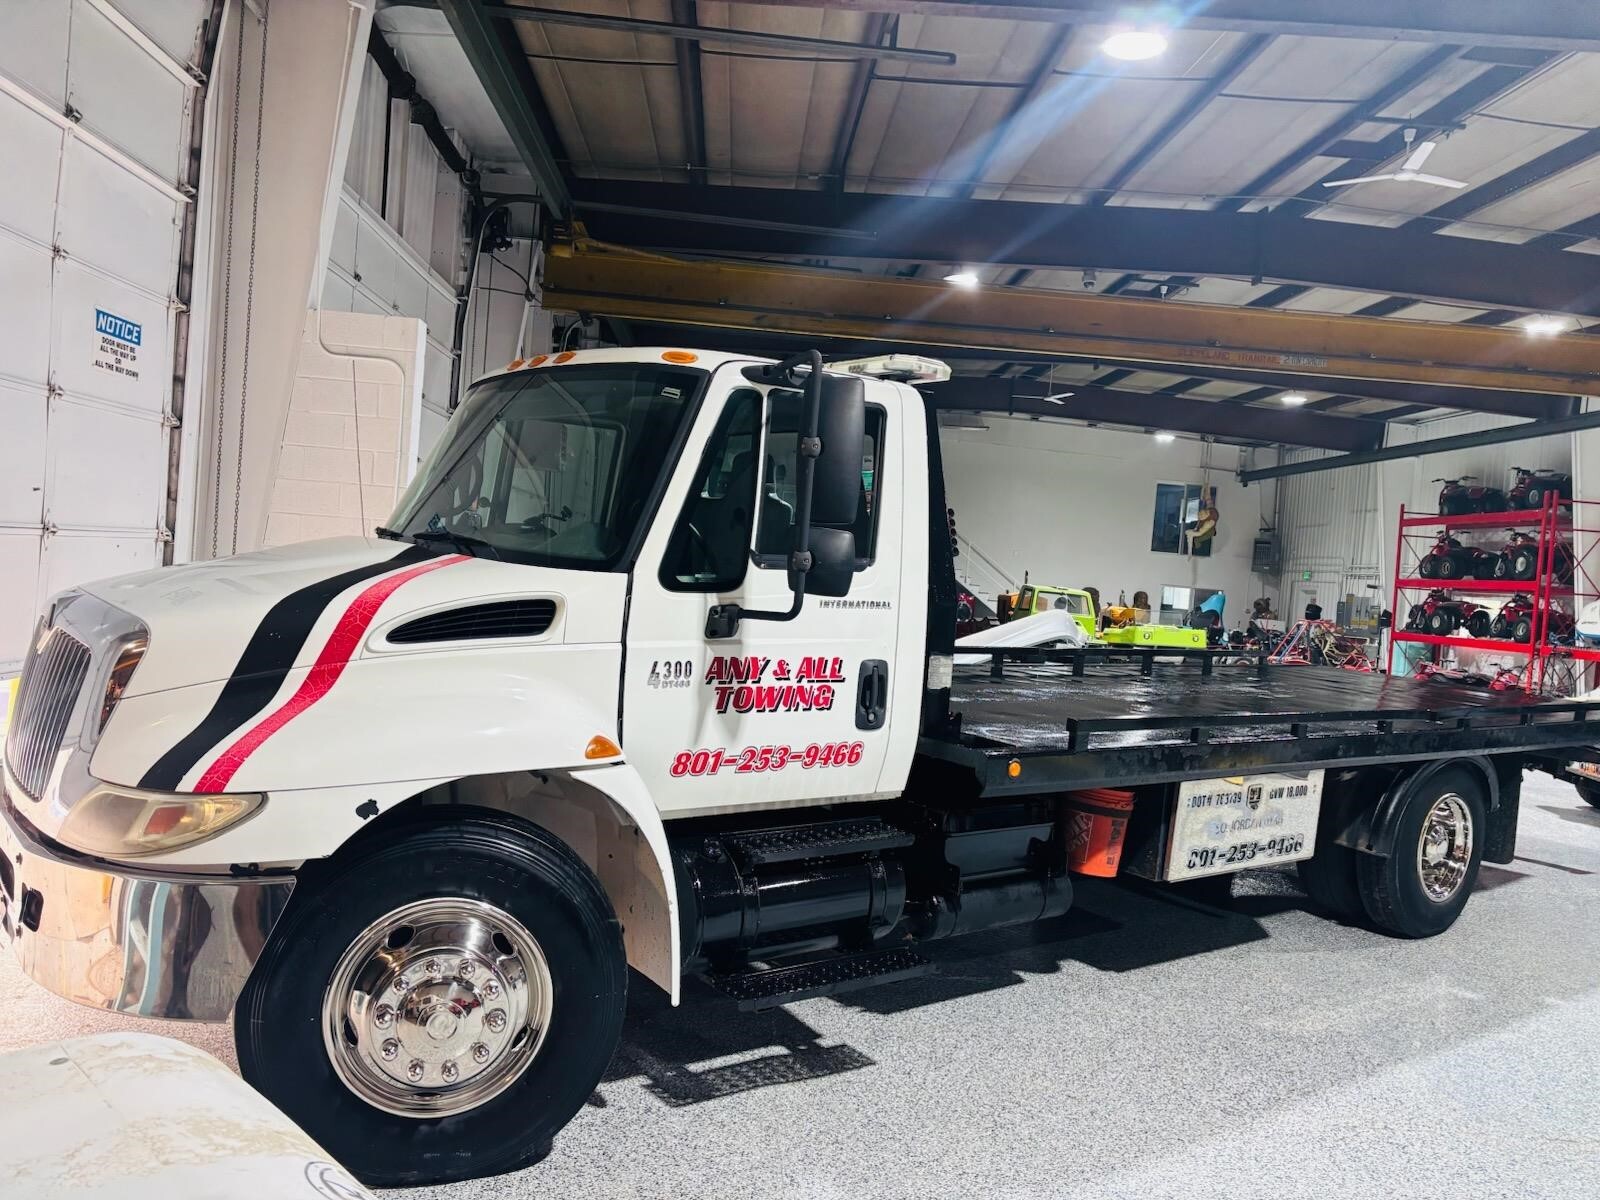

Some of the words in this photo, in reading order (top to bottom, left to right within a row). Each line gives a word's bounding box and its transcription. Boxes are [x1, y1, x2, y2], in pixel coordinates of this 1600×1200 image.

[97, 313, 140, 342] NOTICE
[100, 344, 109, 353] ALL
[110, 347, 118, 356] THE
[120, 351, 129, 359] WAY
[102, 336, 115, 347] DOOR
[116, 341, 129, 350] MUST
[130, 346, 136, 354] BE
[95, 360, 104, 369] ALL
[105, 362, 114, 371] THE
[115, 366, 124, 374] WAY
[125, 369, 139, 379] DOWN
[115, 357, 122, 365] OR
[818, 600, 892, 610] INTERNATIONAL
[647, 660, 693, 688] 4300
[705, 656, 770, 684] ANY
[772, 658, 790, 682] &
[795, 656, 846, 683] ALL
[714, 684, 835, 714] TOWING
[670, 741, 865, 777] 801-253-9466
[1269, 787, 1285, 799] GVW
